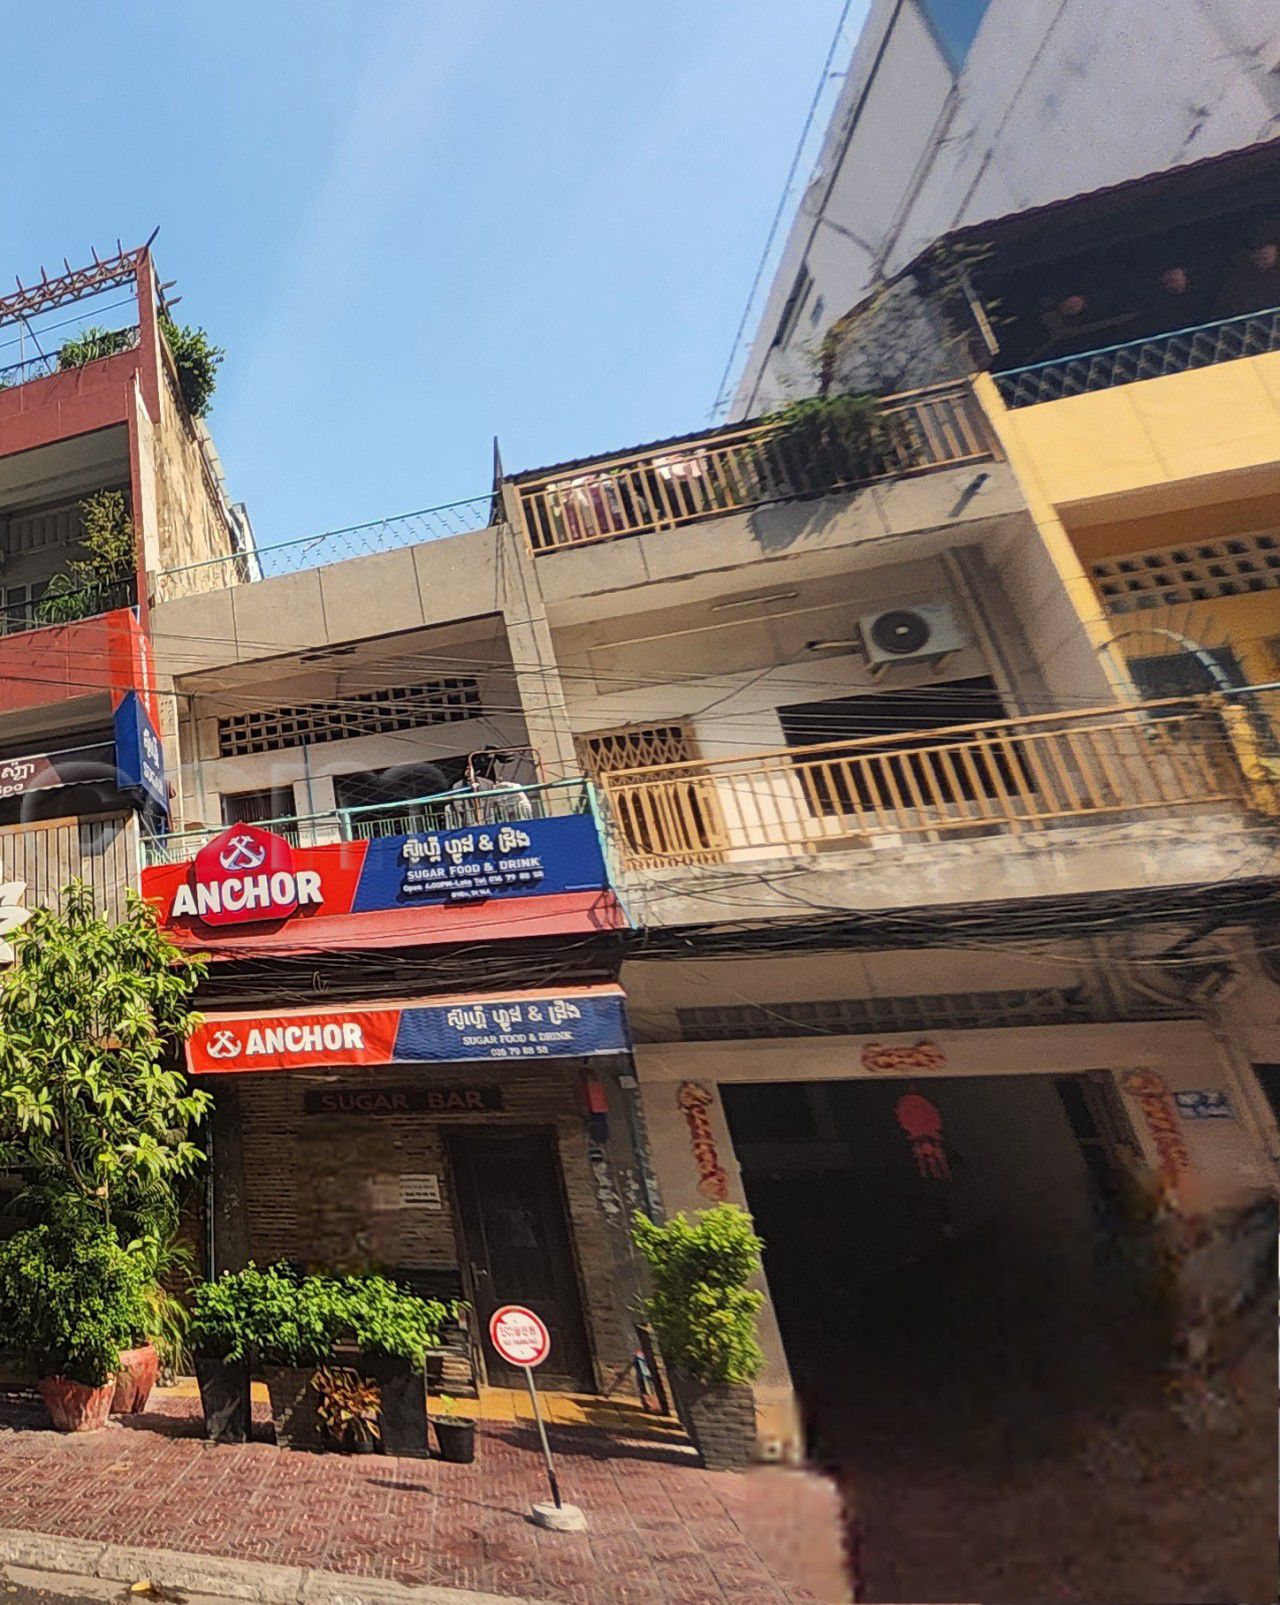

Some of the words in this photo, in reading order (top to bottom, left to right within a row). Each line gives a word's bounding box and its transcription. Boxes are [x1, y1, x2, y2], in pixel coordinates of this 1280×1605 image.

[478, 834, 494, 851] &
[407, 867, 445, 880] SUGAR
[449, 864, 481, 876] FOOD
[483, 862, 494, 872] &
[498, 857, 541, 870] DRINK
[171, 870, 324, 917] ANCHOR
[527, 1005, 544, 1022] &
[245, 1022, 365, 1056] ANCHOR
[462, 1035, 498, 1046] SUGAR
[499, 1033, 527, 1044] FOOD
[528, 1033, 538, 1042] &
[538, 1031, 574, 1042] DRINK
[320, 1093, 409, 1111] SUGAR
[426, 1090, 486, 1109] BAR
